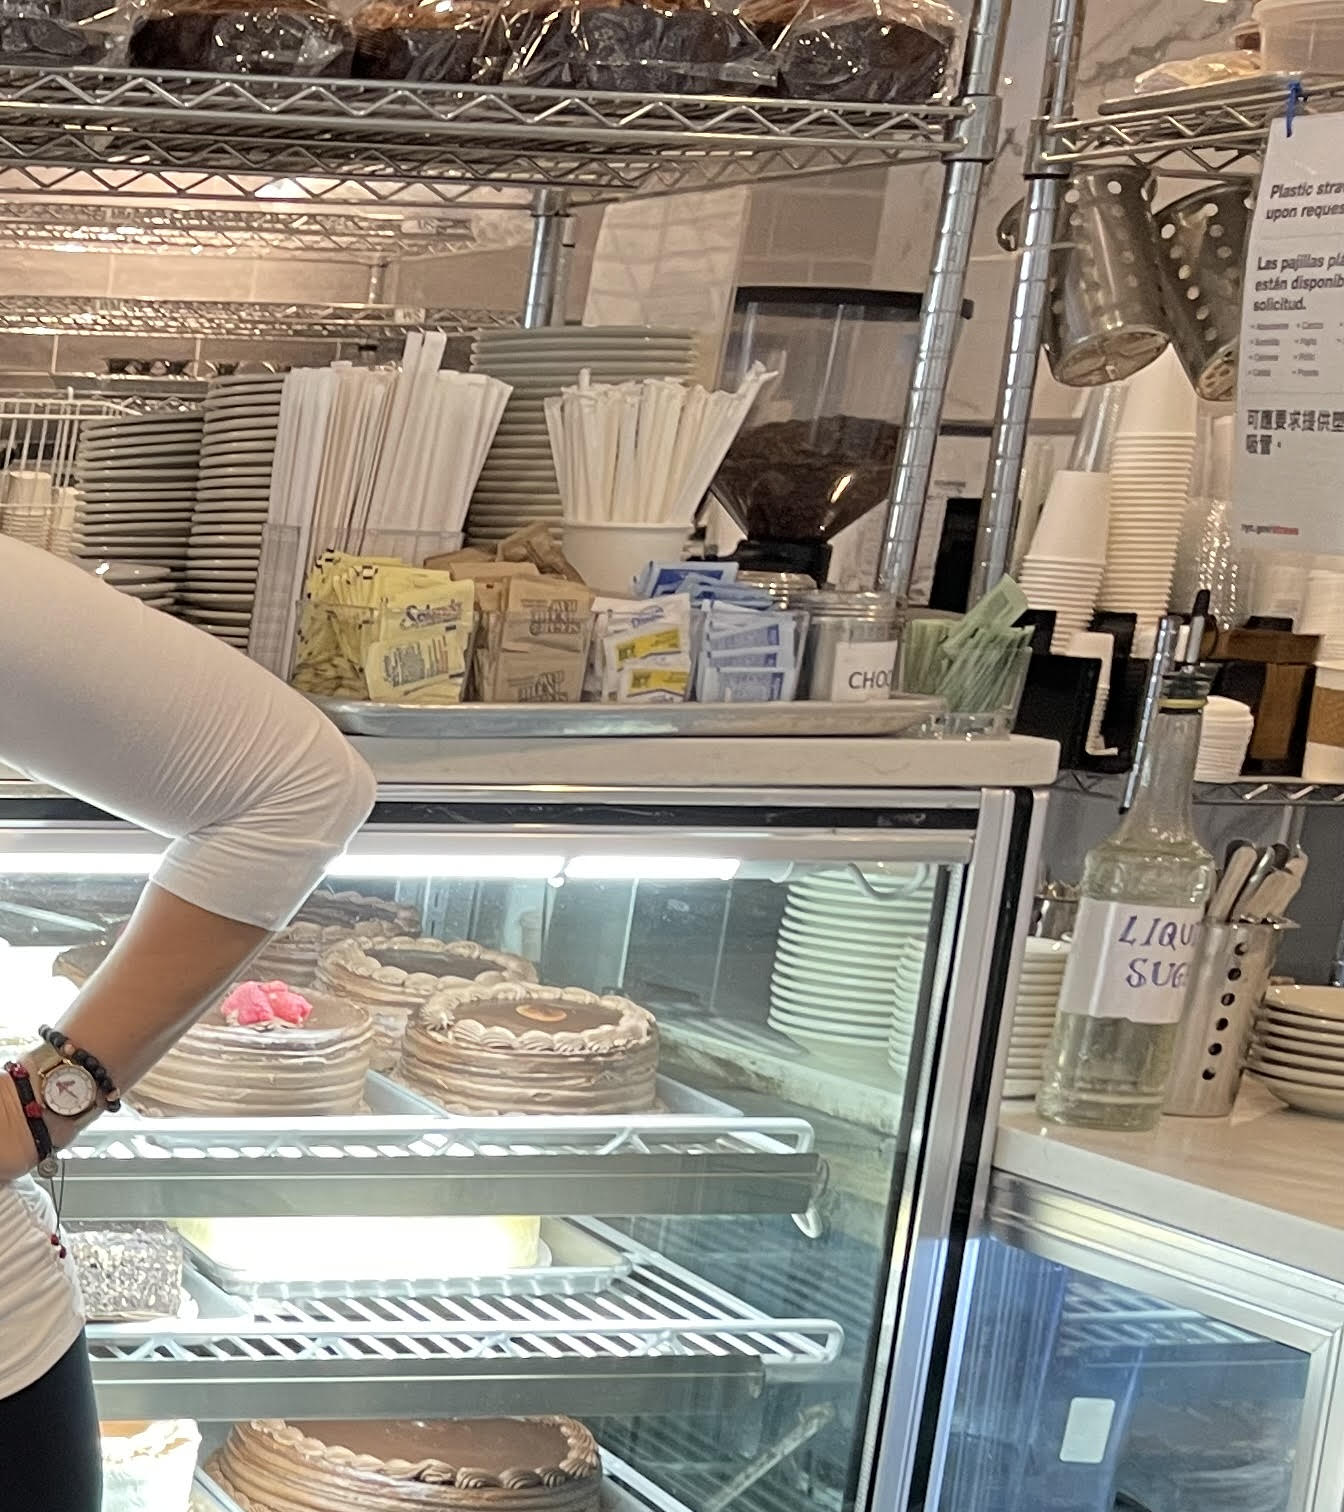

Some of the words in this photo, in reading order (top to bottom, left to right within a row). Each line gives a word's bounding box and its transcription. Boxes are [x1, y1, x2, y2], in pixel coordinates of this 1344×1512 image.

[1270, 182, 1313, 199] Plastic
[1316, 181, 1344, 196] stra
[1265, 207, 1297, 222] upon
[1257, 256, 1278, 271] Las
[1255, 277, 1287, 292] están
